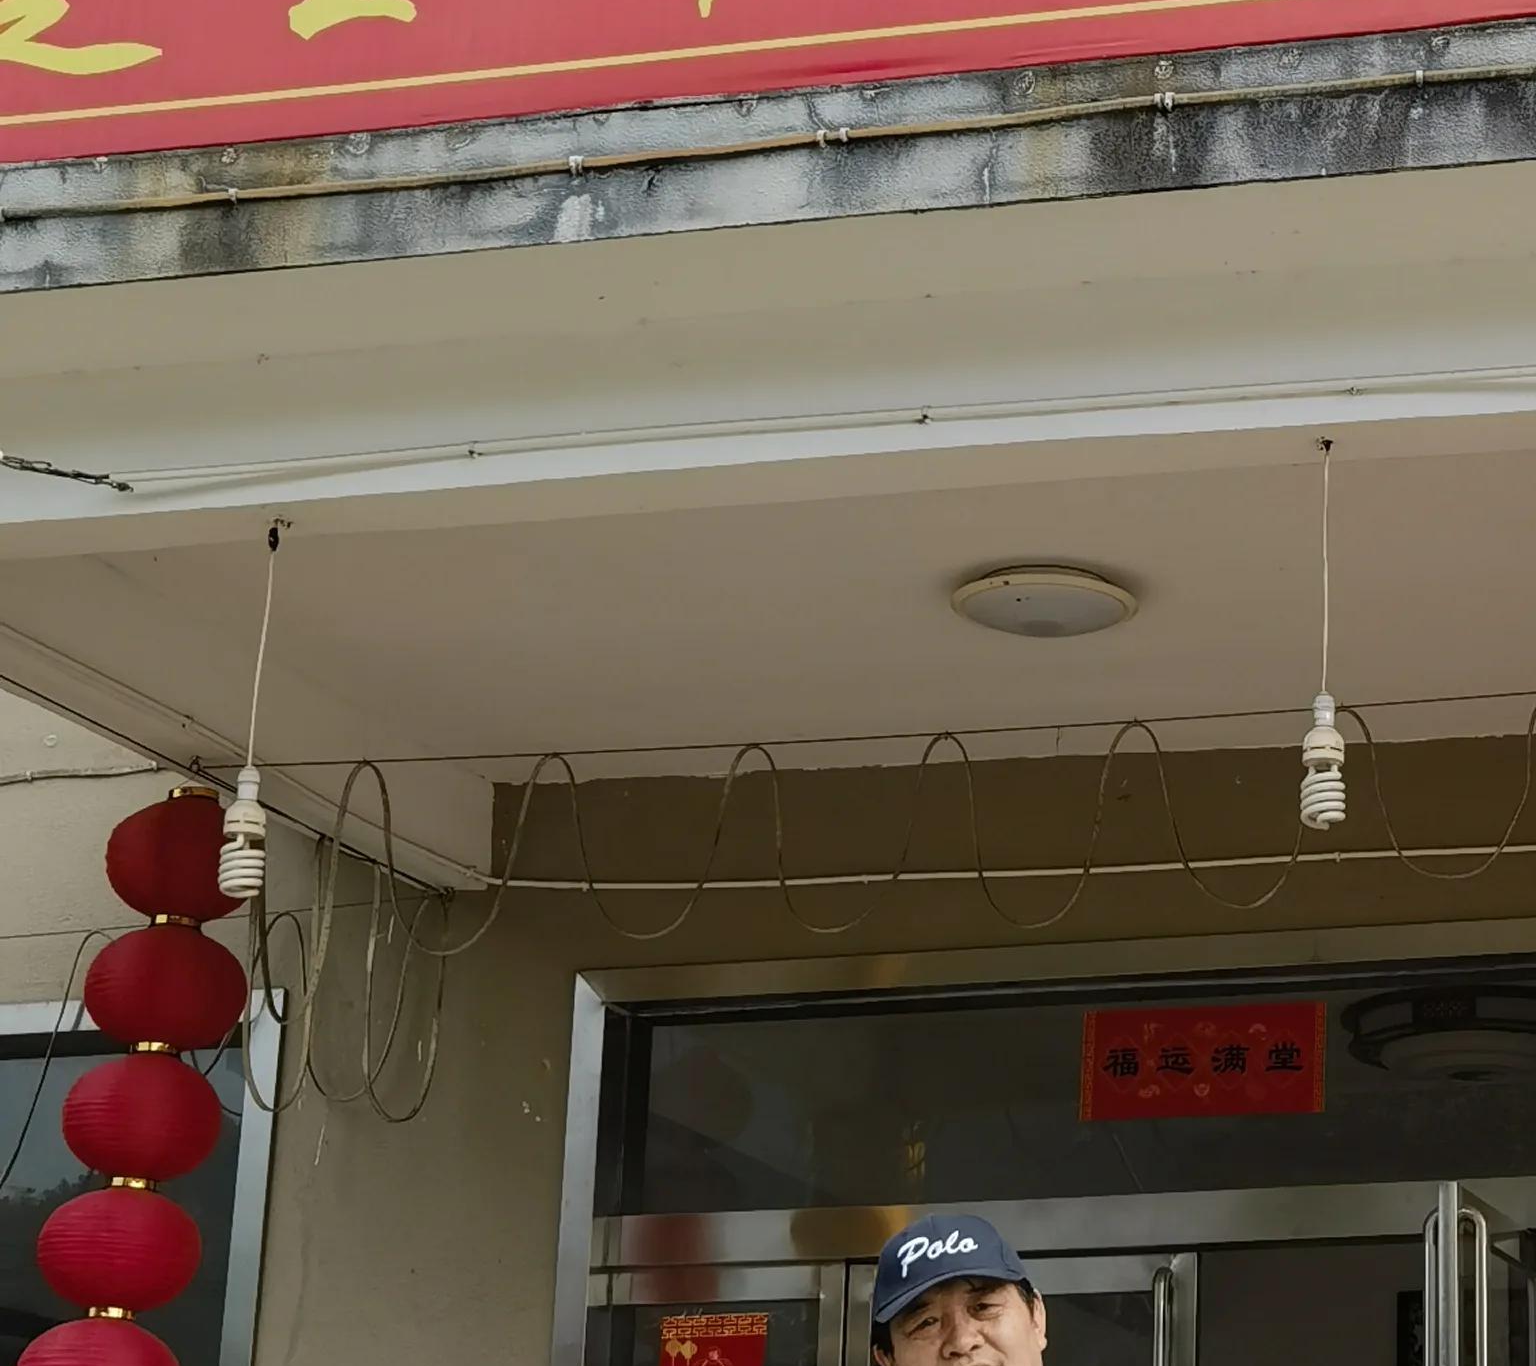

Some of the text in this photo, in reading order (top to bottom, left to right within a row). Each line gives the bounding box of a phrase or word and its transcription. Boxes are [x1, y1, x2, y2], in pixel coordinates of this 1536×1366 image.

[1102, 1041, 1303, 1077] 福运满堂
[897, 1230, 978, 1278] Polo
